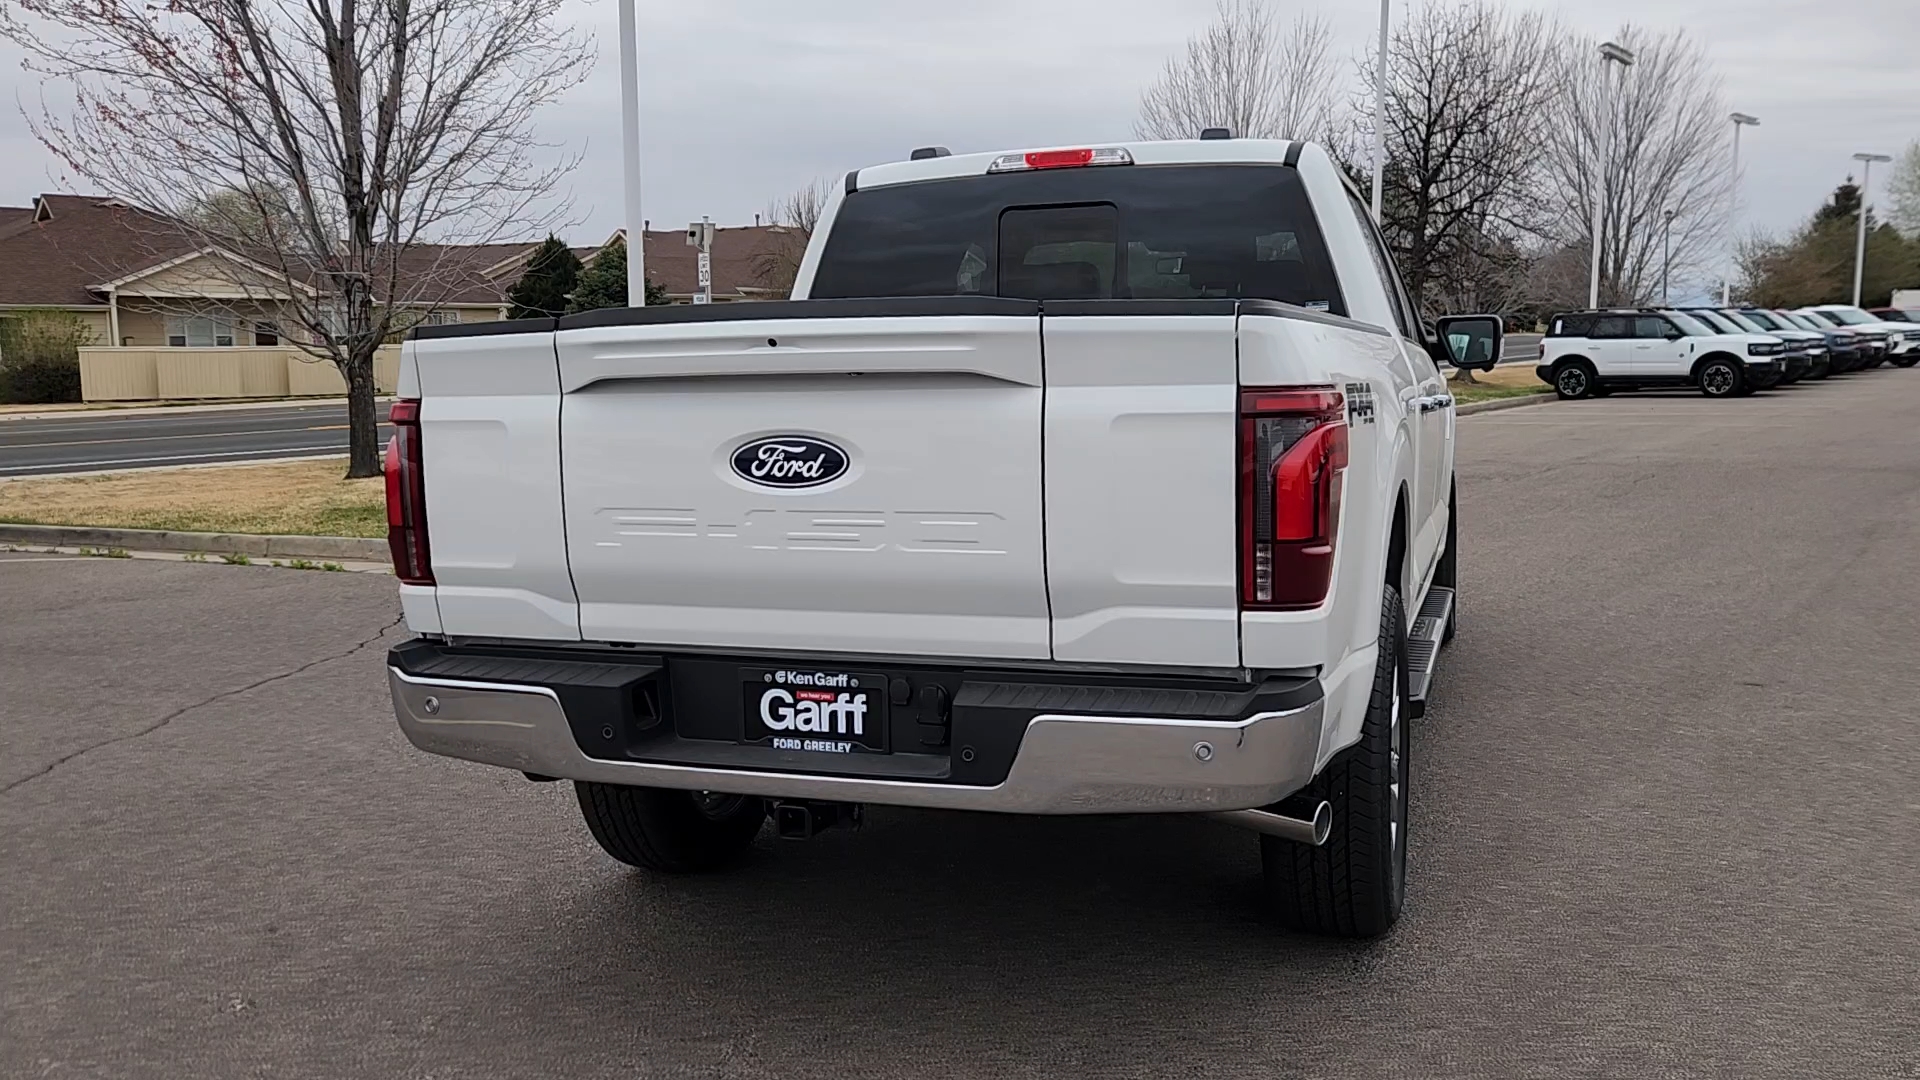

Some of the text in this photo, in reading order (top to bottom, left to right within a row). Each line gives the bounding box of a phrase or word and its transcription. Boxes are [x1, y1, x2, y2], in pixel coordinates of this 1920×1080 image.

[700, 270, 709, 282] 30
[751, 444, 826, 478] Ford
[787, 671, 848, 687] Ken Garff
[760, 688, 867, 735] Garff
[773, 738, 851, 753] FORD GREELEY
